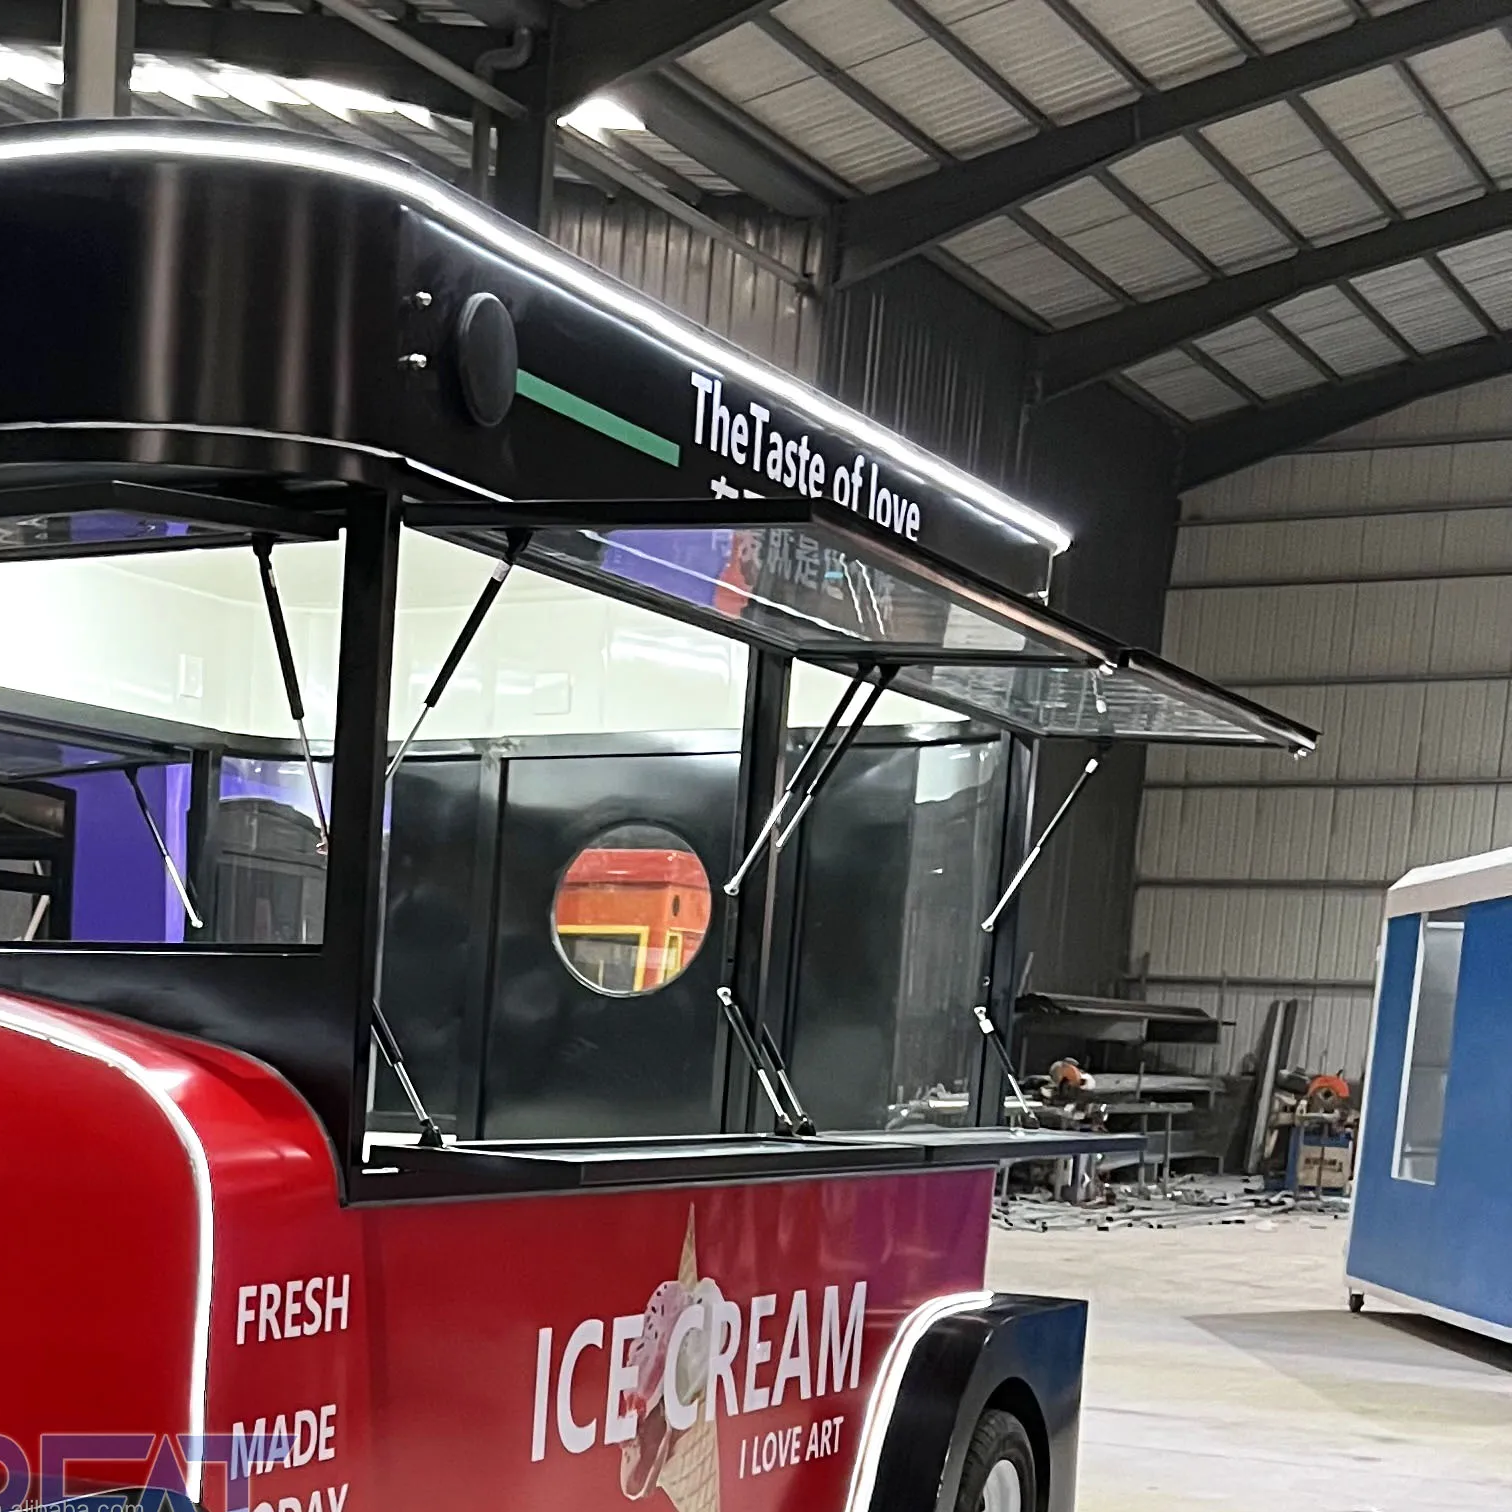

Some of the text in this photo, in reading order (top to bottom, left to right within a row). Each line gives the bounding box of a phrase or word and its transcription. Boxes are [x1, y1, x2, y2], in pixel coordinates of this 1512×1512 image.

[833, 454, 865, 512] of
[868, 462, 920, 542] love
[236, 1274, 350, 1345] FRESH
[531, 1281, 867, 1462] ICE CREAM
[230, 1404, 337, 1480] MADE
[738, 1416, 844, 1479] I LOVE ART
